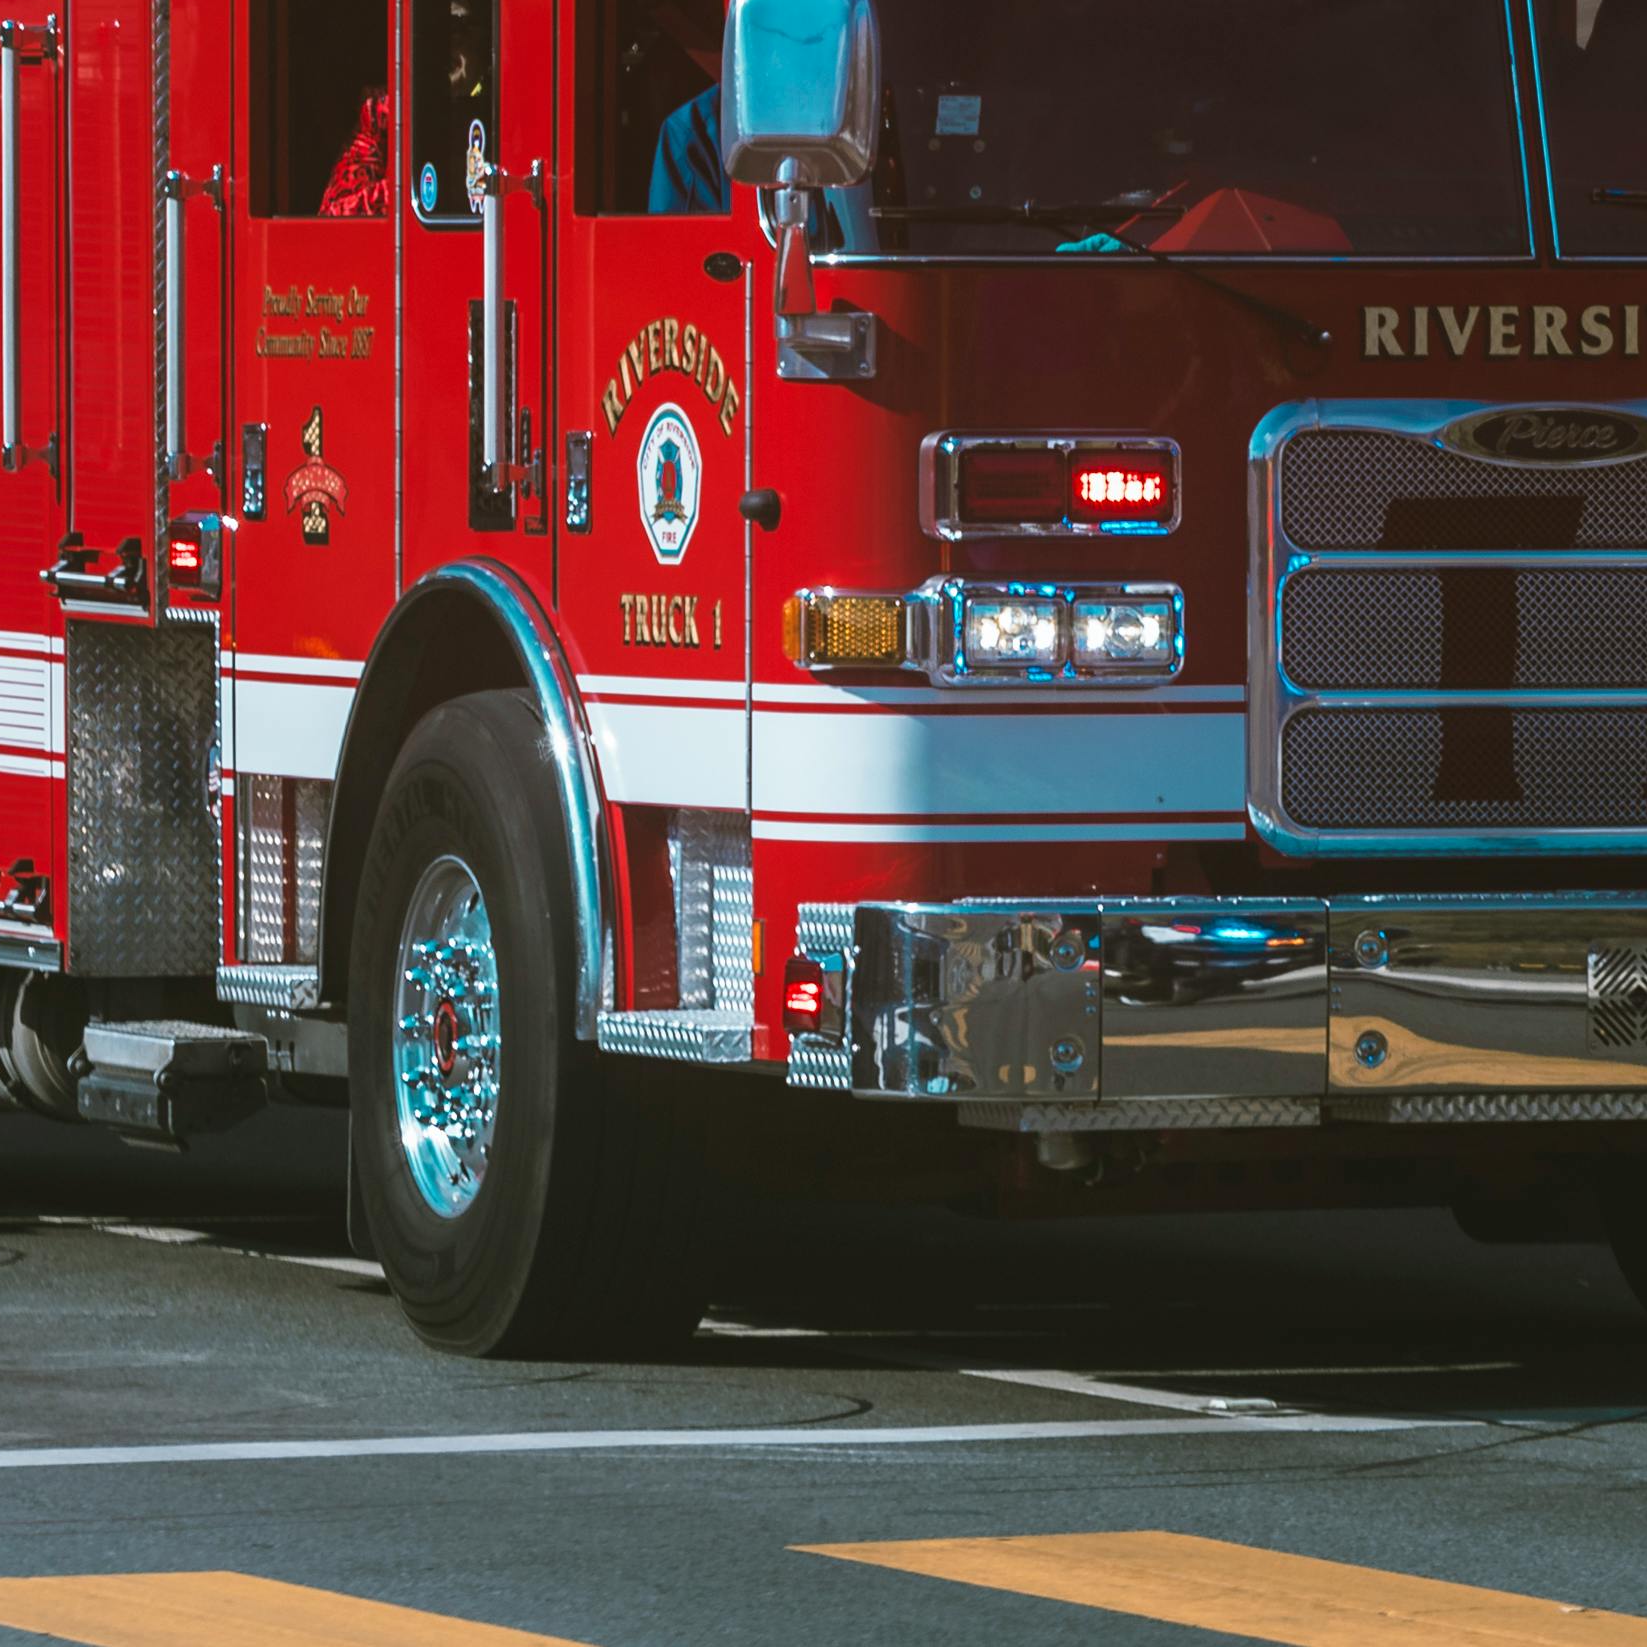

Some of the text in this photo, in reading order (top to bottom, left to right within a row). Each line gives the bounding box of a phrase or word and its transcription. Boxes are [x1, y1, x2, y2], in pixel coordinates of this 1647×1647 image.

[602, 316, 740, 439] RIVERSIDE
[1495, 413, 1619, 453] Pierce
[661, 530, 677, 545] FIRE
[620, 593, 722, 651] TRUCK 1
